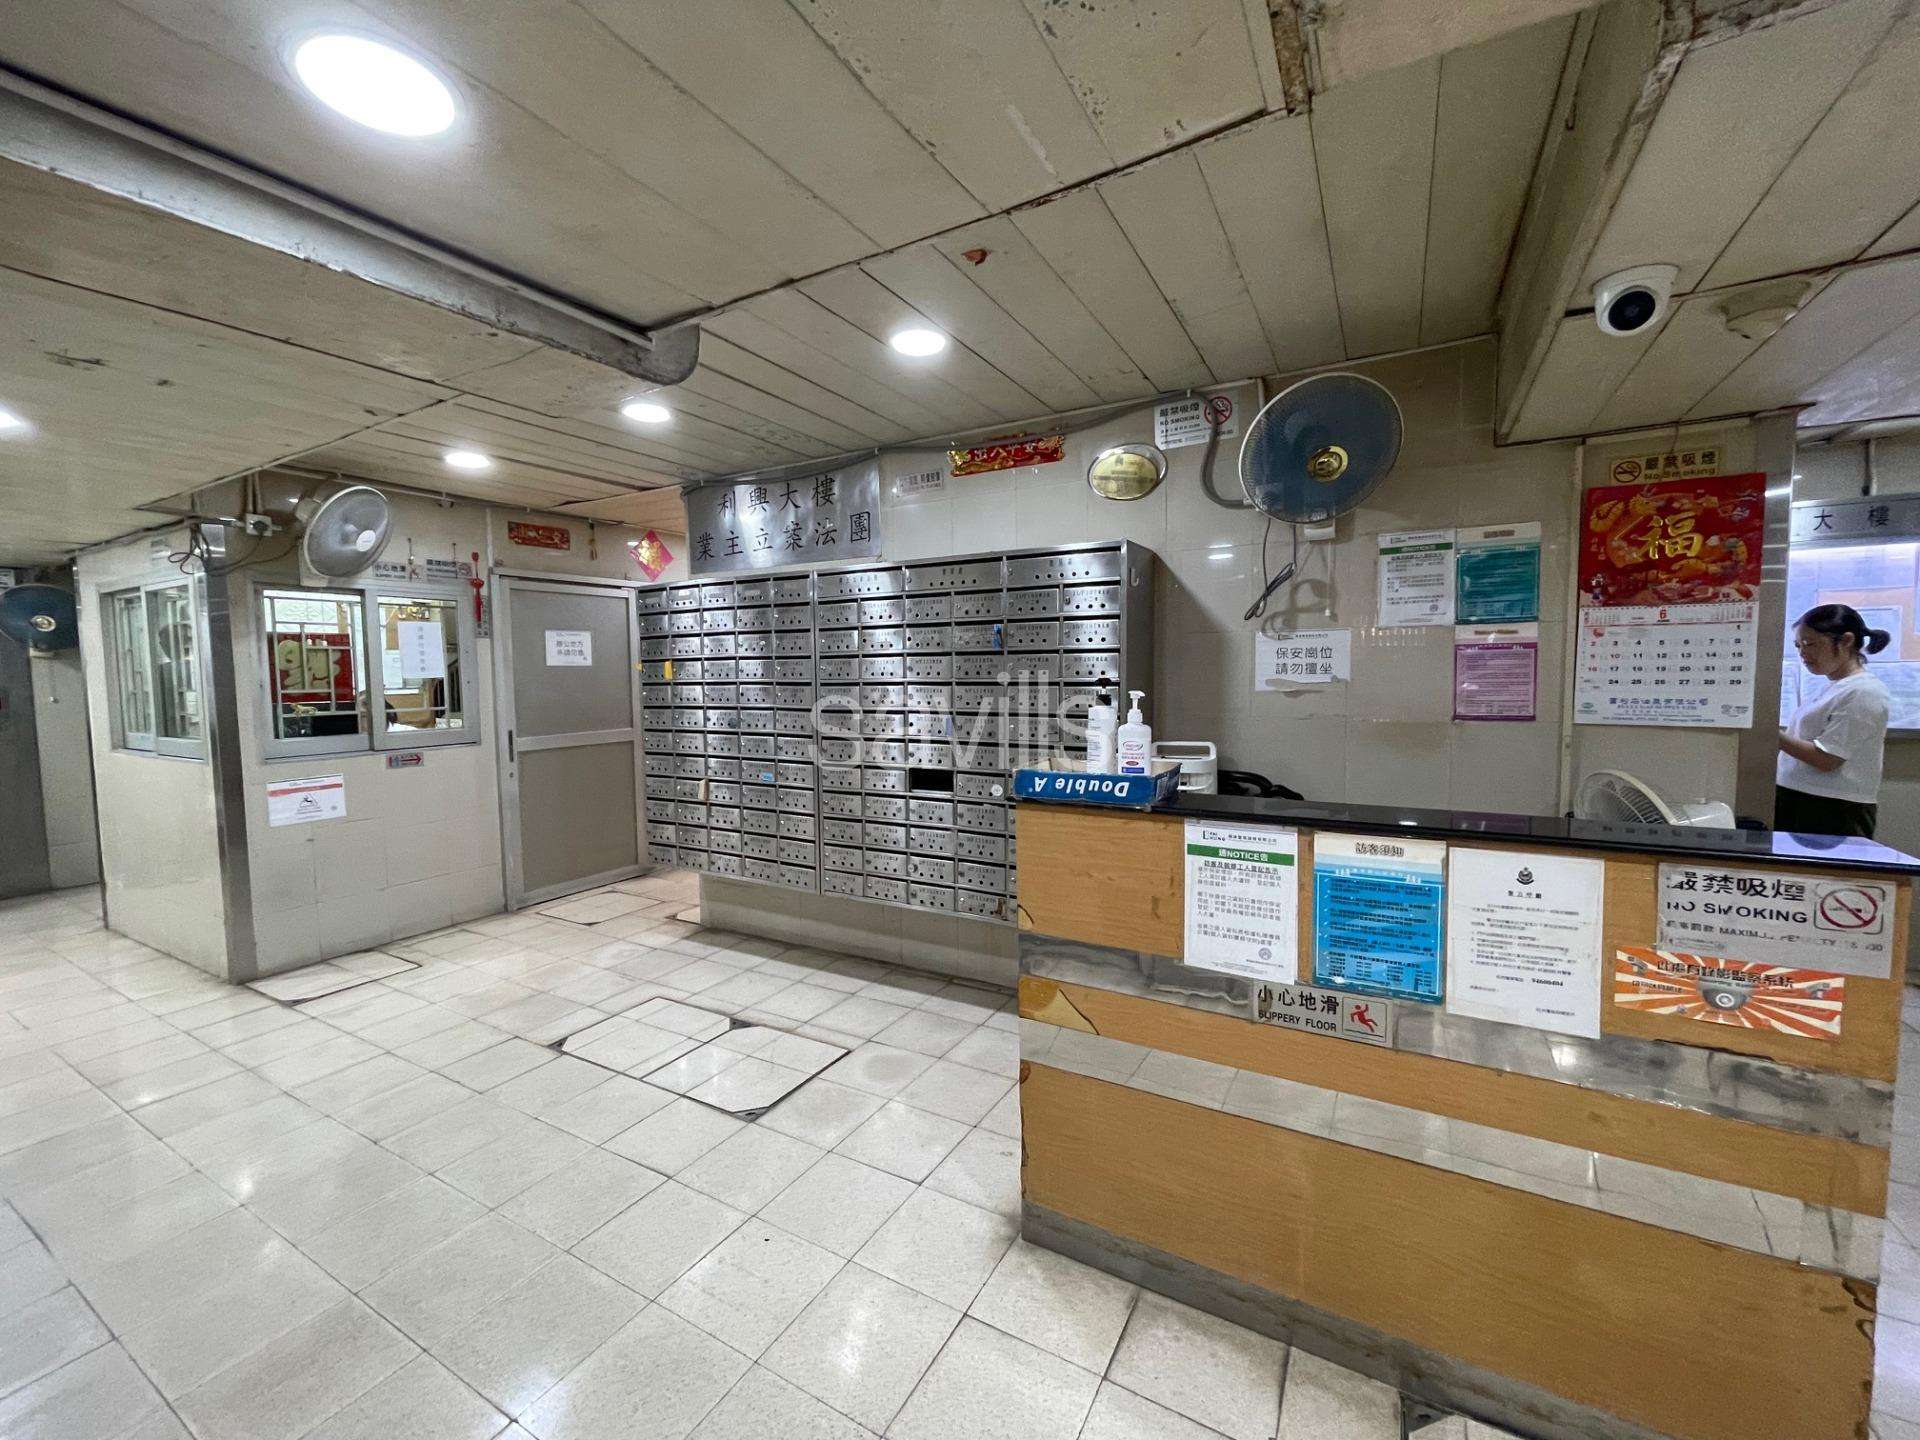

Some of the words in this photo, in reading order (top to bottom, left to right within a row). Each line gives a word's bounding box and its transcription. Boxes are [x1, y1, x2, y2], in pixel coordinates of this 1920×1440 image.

[717, 474, 837, 518] 利興大樓
[1813, 505, 1889, 531] 大樓
[1631, 510, 1702, 559] 福
[1659, 609, 1667, 619] 6
[1275, 646, 1334, 660] 保安崗位
[1275, 662, 1334, 675] 請勿擅坐
[1033, 776, 1047, 786] A
[1055, 777, 1130, 797] Double
[1257, 984, 1340, 1015] 小心地滑
[1258, 1009, 1301, 1025] SLIPPERY
[1305, 1018, 1337, 1032] FLOOR
